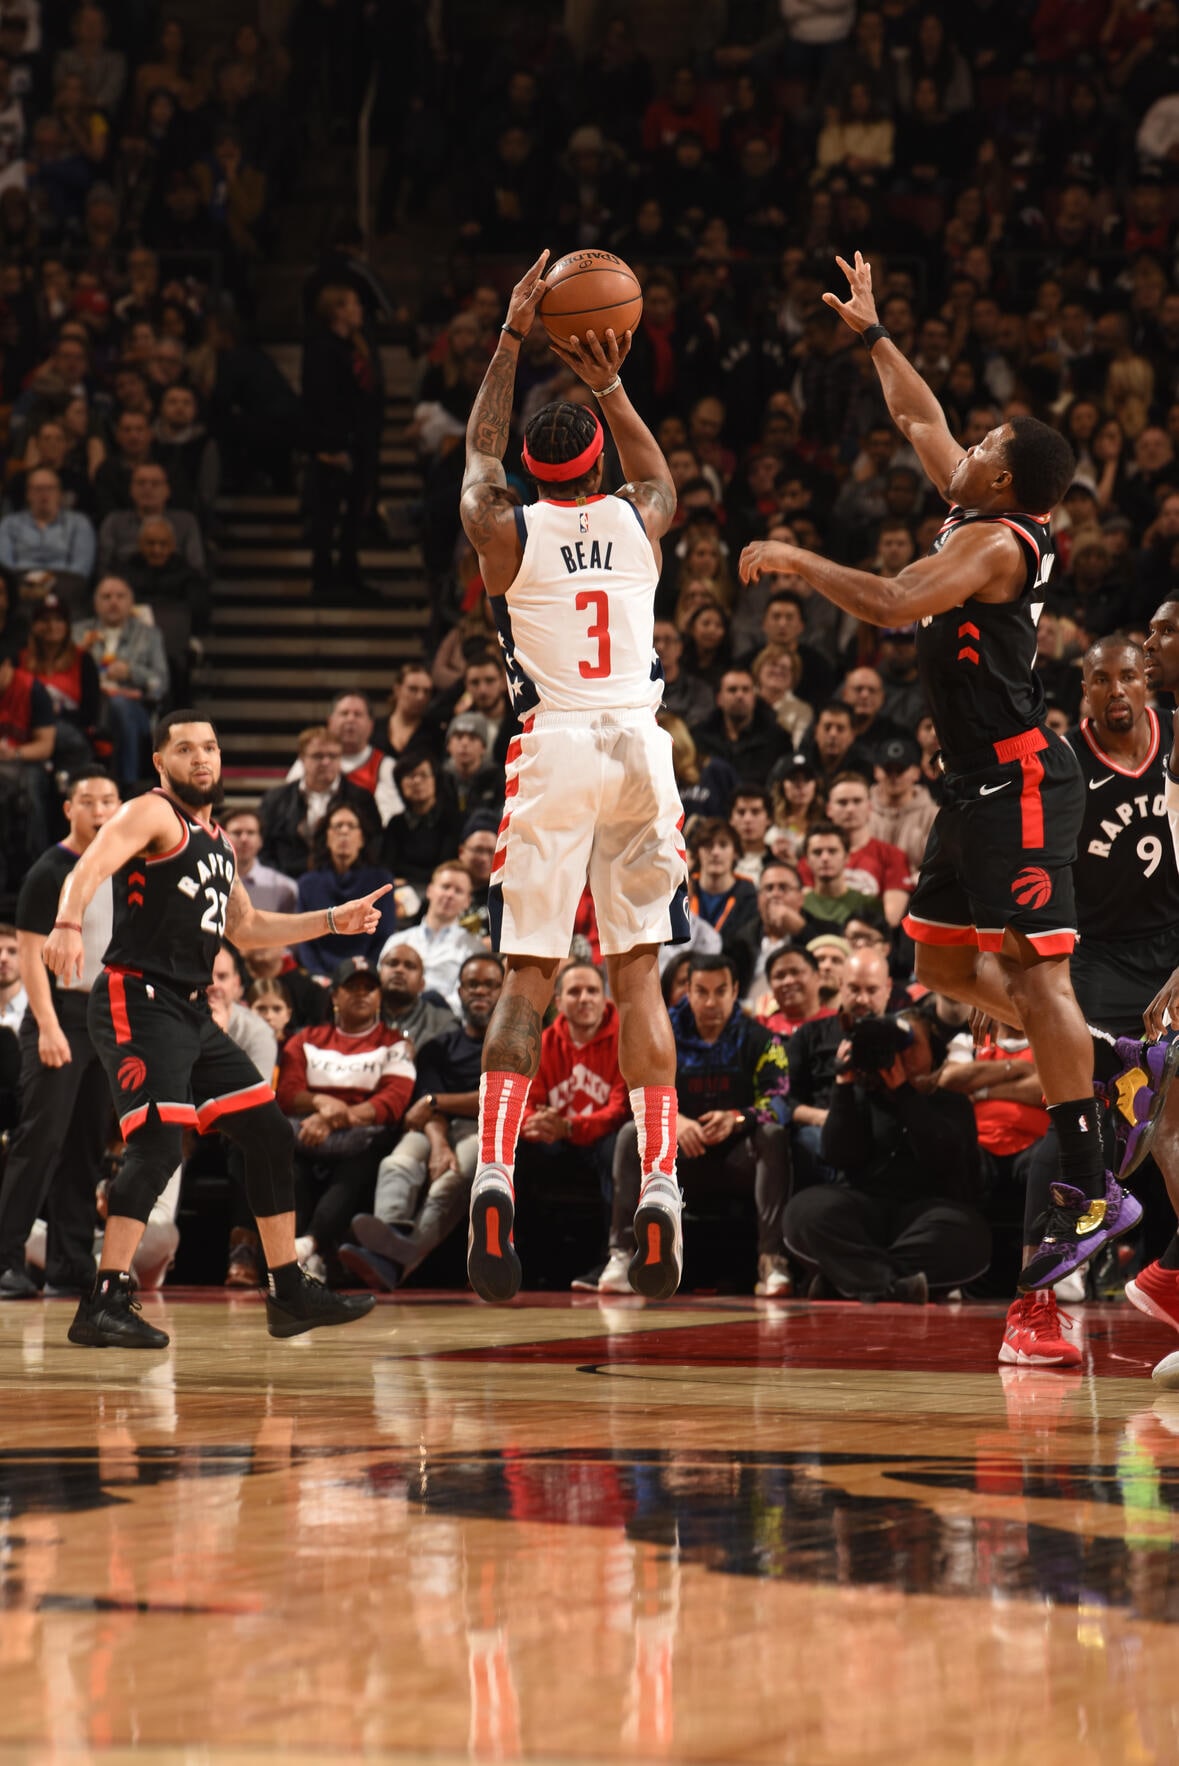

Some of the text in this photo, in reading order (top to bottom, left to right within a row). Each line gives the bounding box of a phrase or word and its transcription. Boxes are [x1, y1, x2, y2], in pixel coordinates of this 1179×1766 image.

[560, 540, 613, 574] BEAL
[575, 590, 611, 679] 3
[1136, 835, 1163, 878] 9
